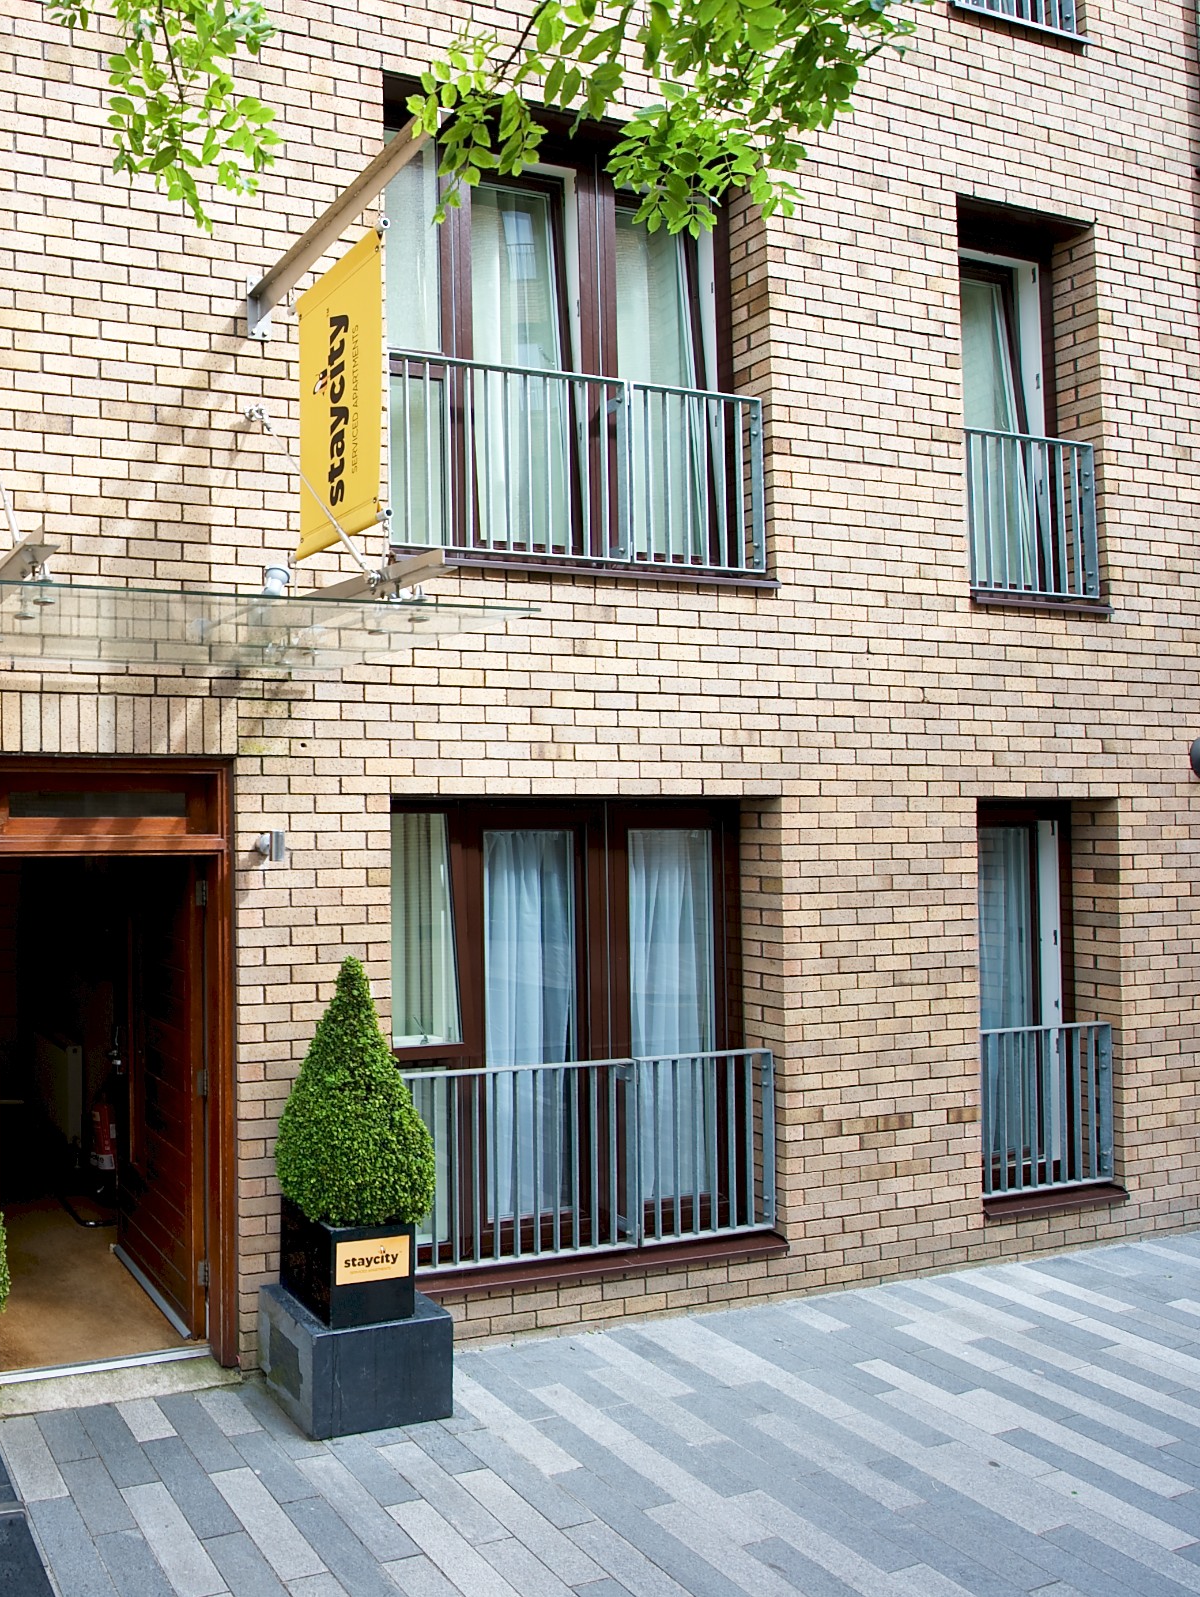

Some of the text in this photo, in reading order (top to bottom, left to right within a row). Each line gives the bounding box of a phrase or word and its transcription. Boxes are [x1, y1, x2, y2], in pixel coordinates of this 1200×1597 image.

[351, 324, 359, 408] APARTMENTS
[328, 314, 349, 506] staycity
[344, 1253, 399, 1268] staycity
